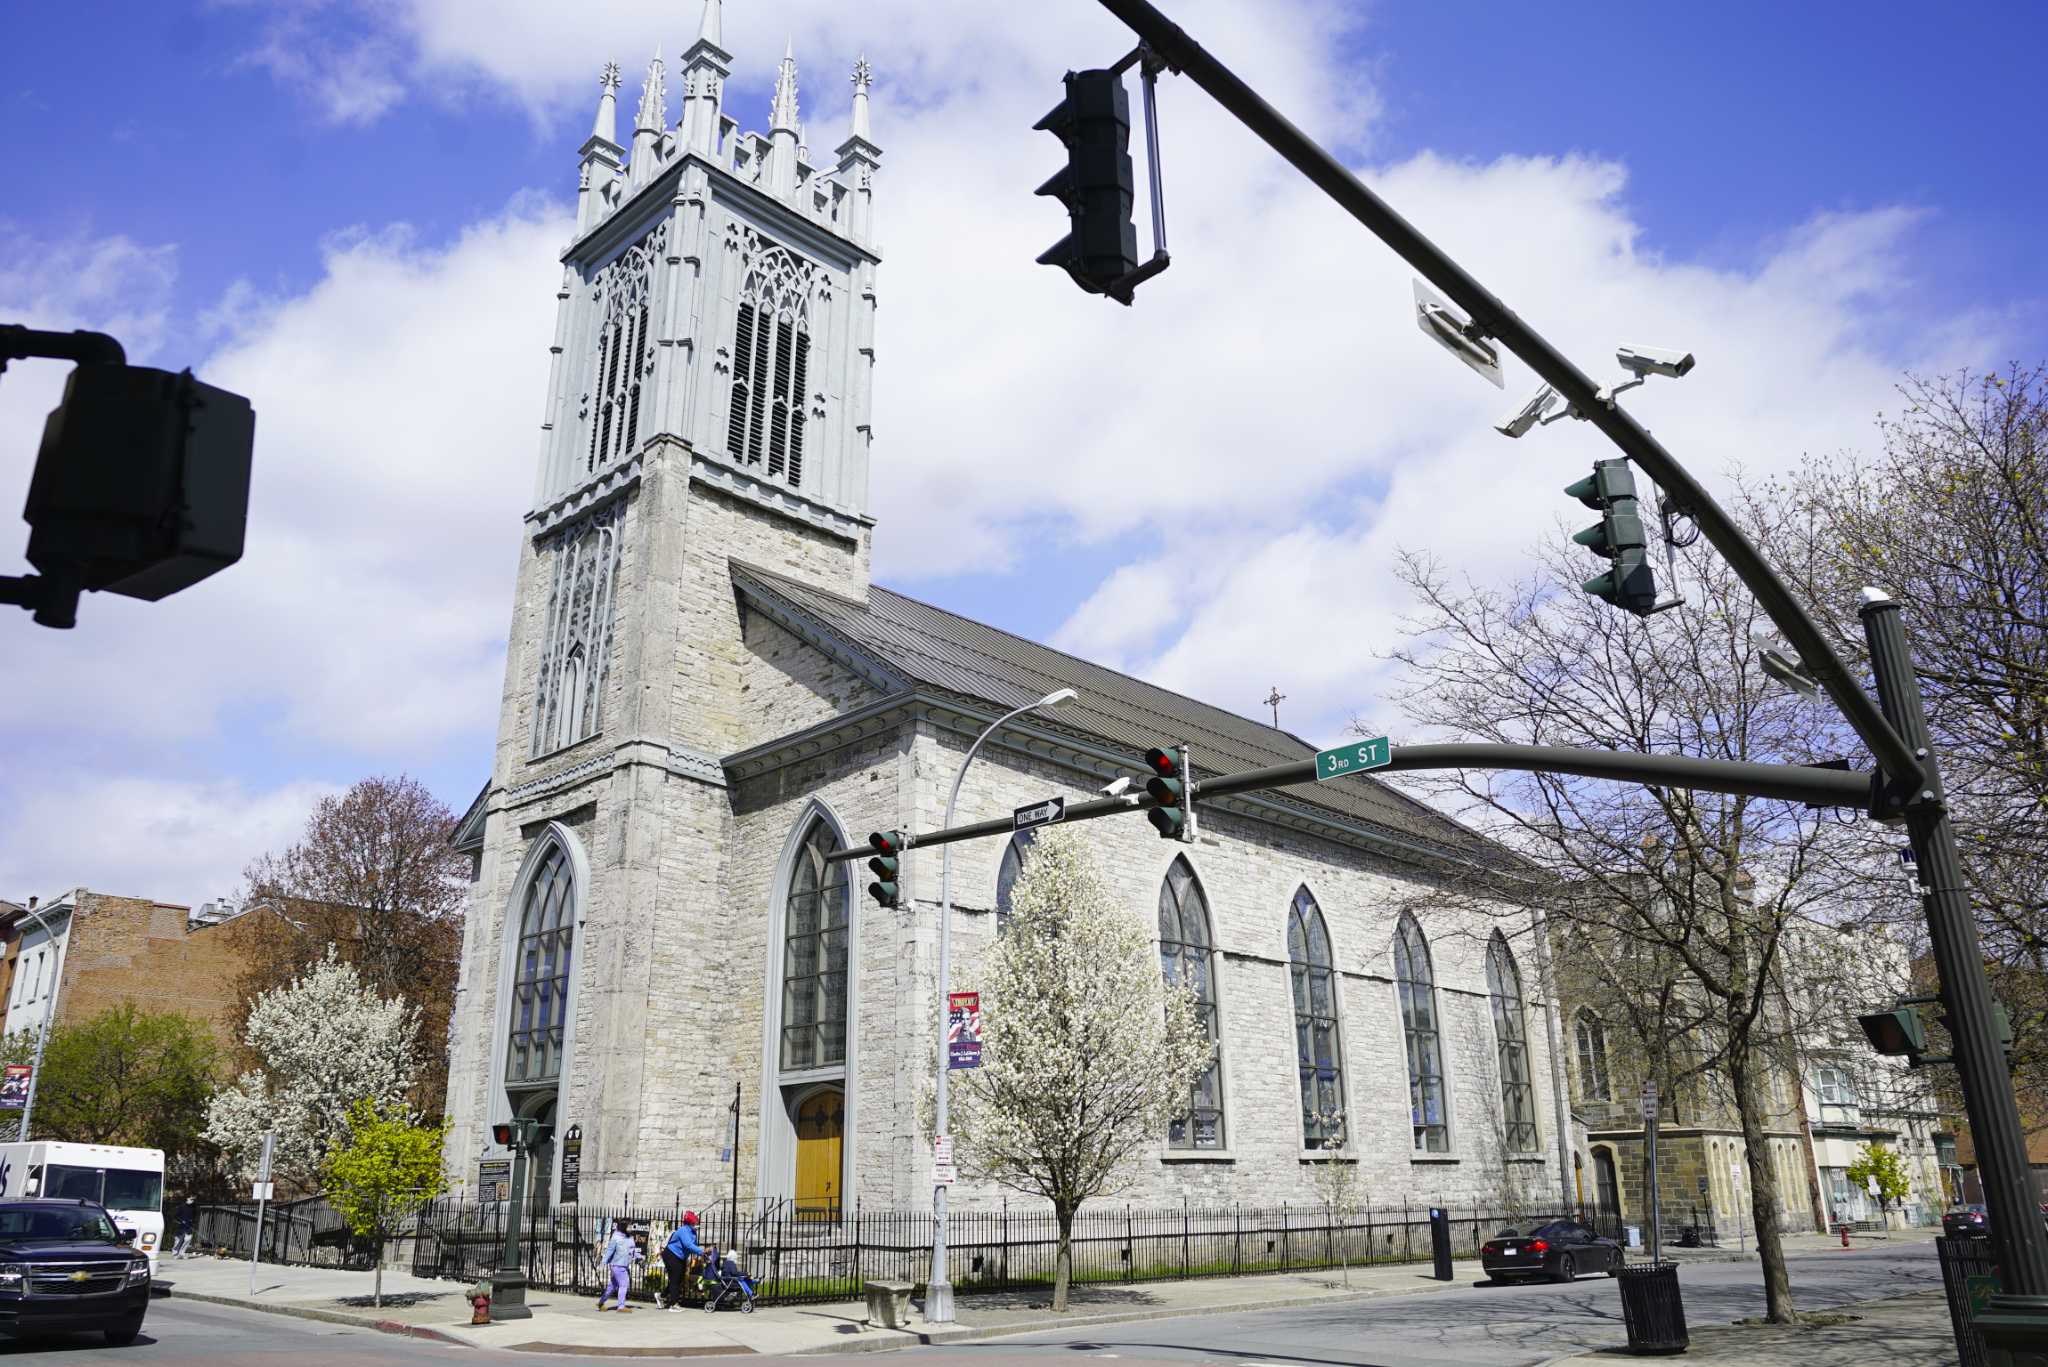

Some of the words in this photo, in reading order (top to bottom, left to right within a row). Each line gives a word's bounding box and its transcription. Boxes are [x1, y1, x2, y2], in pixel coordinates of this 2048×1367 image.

[1328, 754, 1349, 771] 3RD
[1358, 744, 1377, 763] ST
[1018, 811, 1032, 823] ONE
[1034, 808, 1047, 818] WAY
